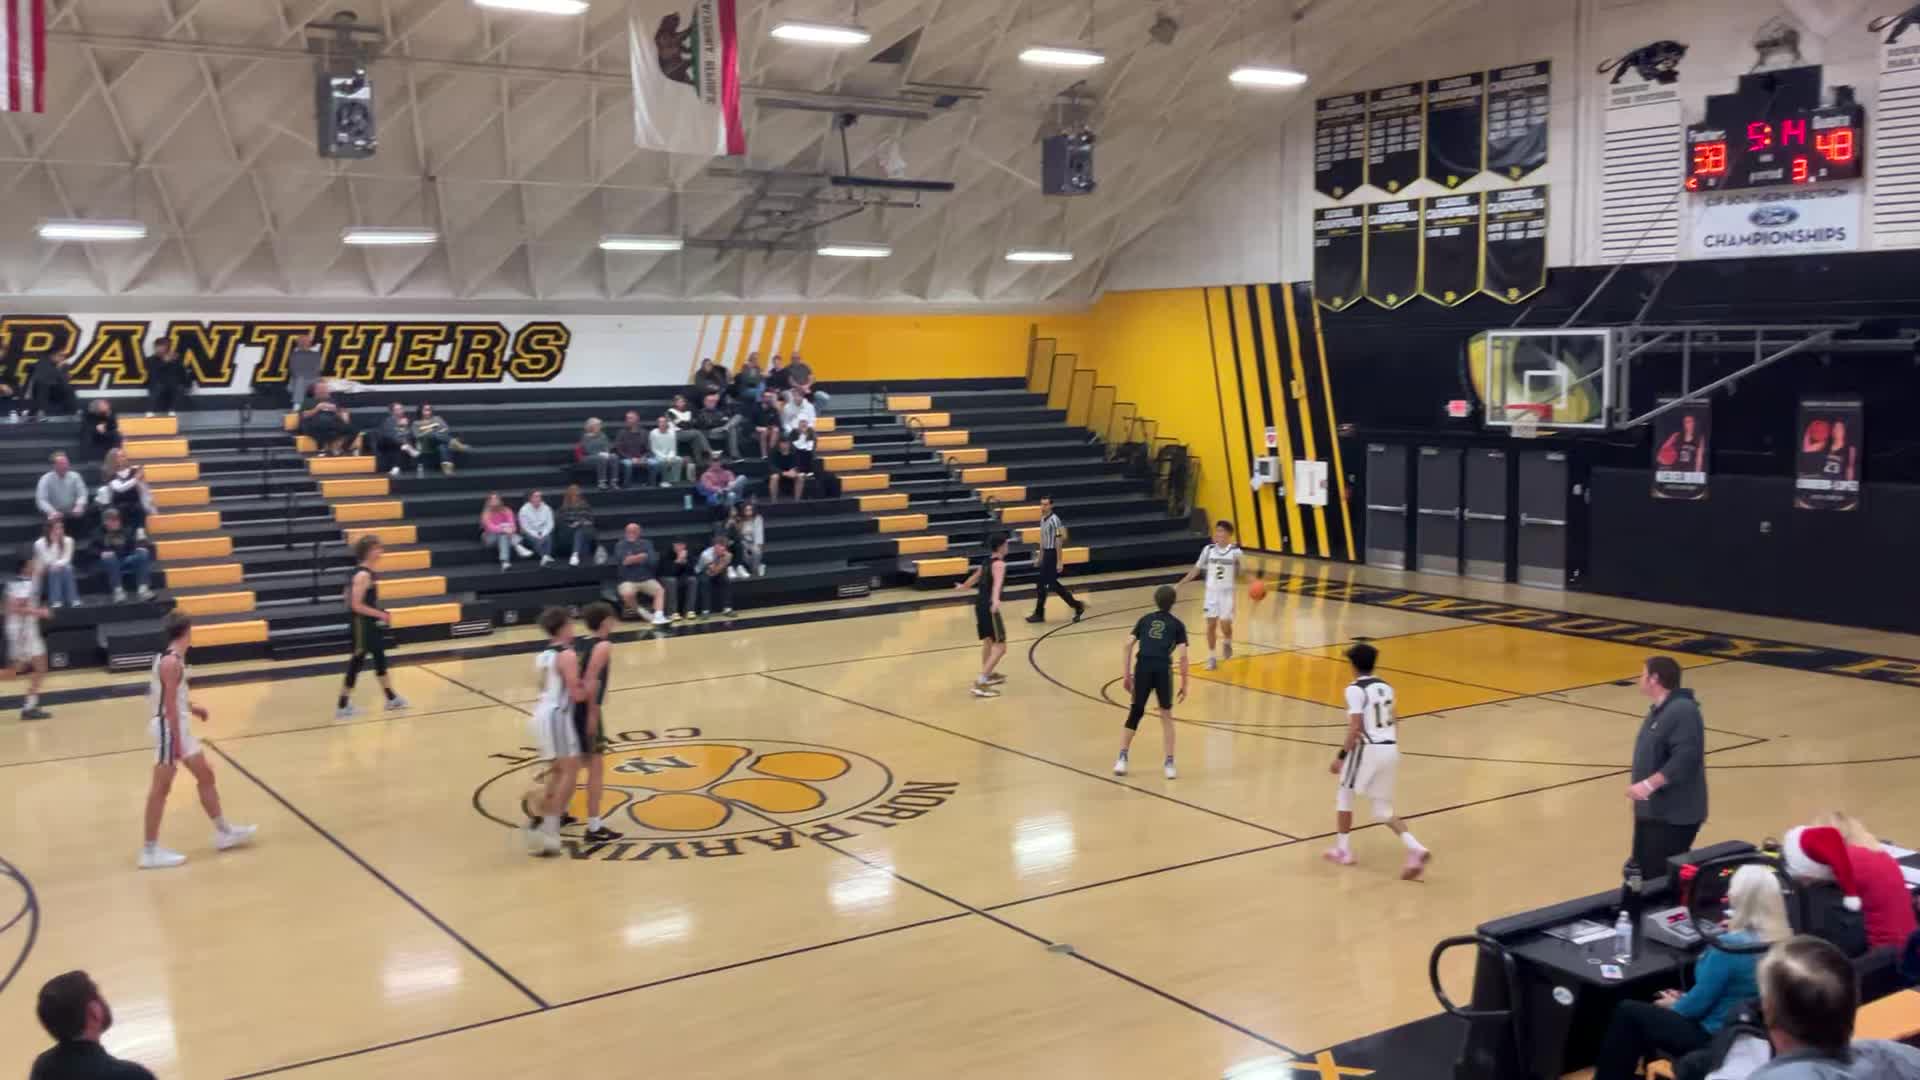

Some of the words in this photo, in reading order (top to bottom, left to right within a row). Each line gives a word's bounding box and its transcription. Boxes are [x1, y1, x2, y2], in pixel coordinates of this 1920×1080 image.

[1694, 143, 1727, 175] 38
[1815, 130, 1854, 161] 48
[1792, 158, 1808, 182] 3
[1703, 227, 1847, 248] CHAMPIONSHIPS
[0, 314, 572, 390] PANTHERS
[1148, 620, 1166, 639] 2
[845, 781, 961, 828] NORI
[560, 823, 860, 862] PARVIN
